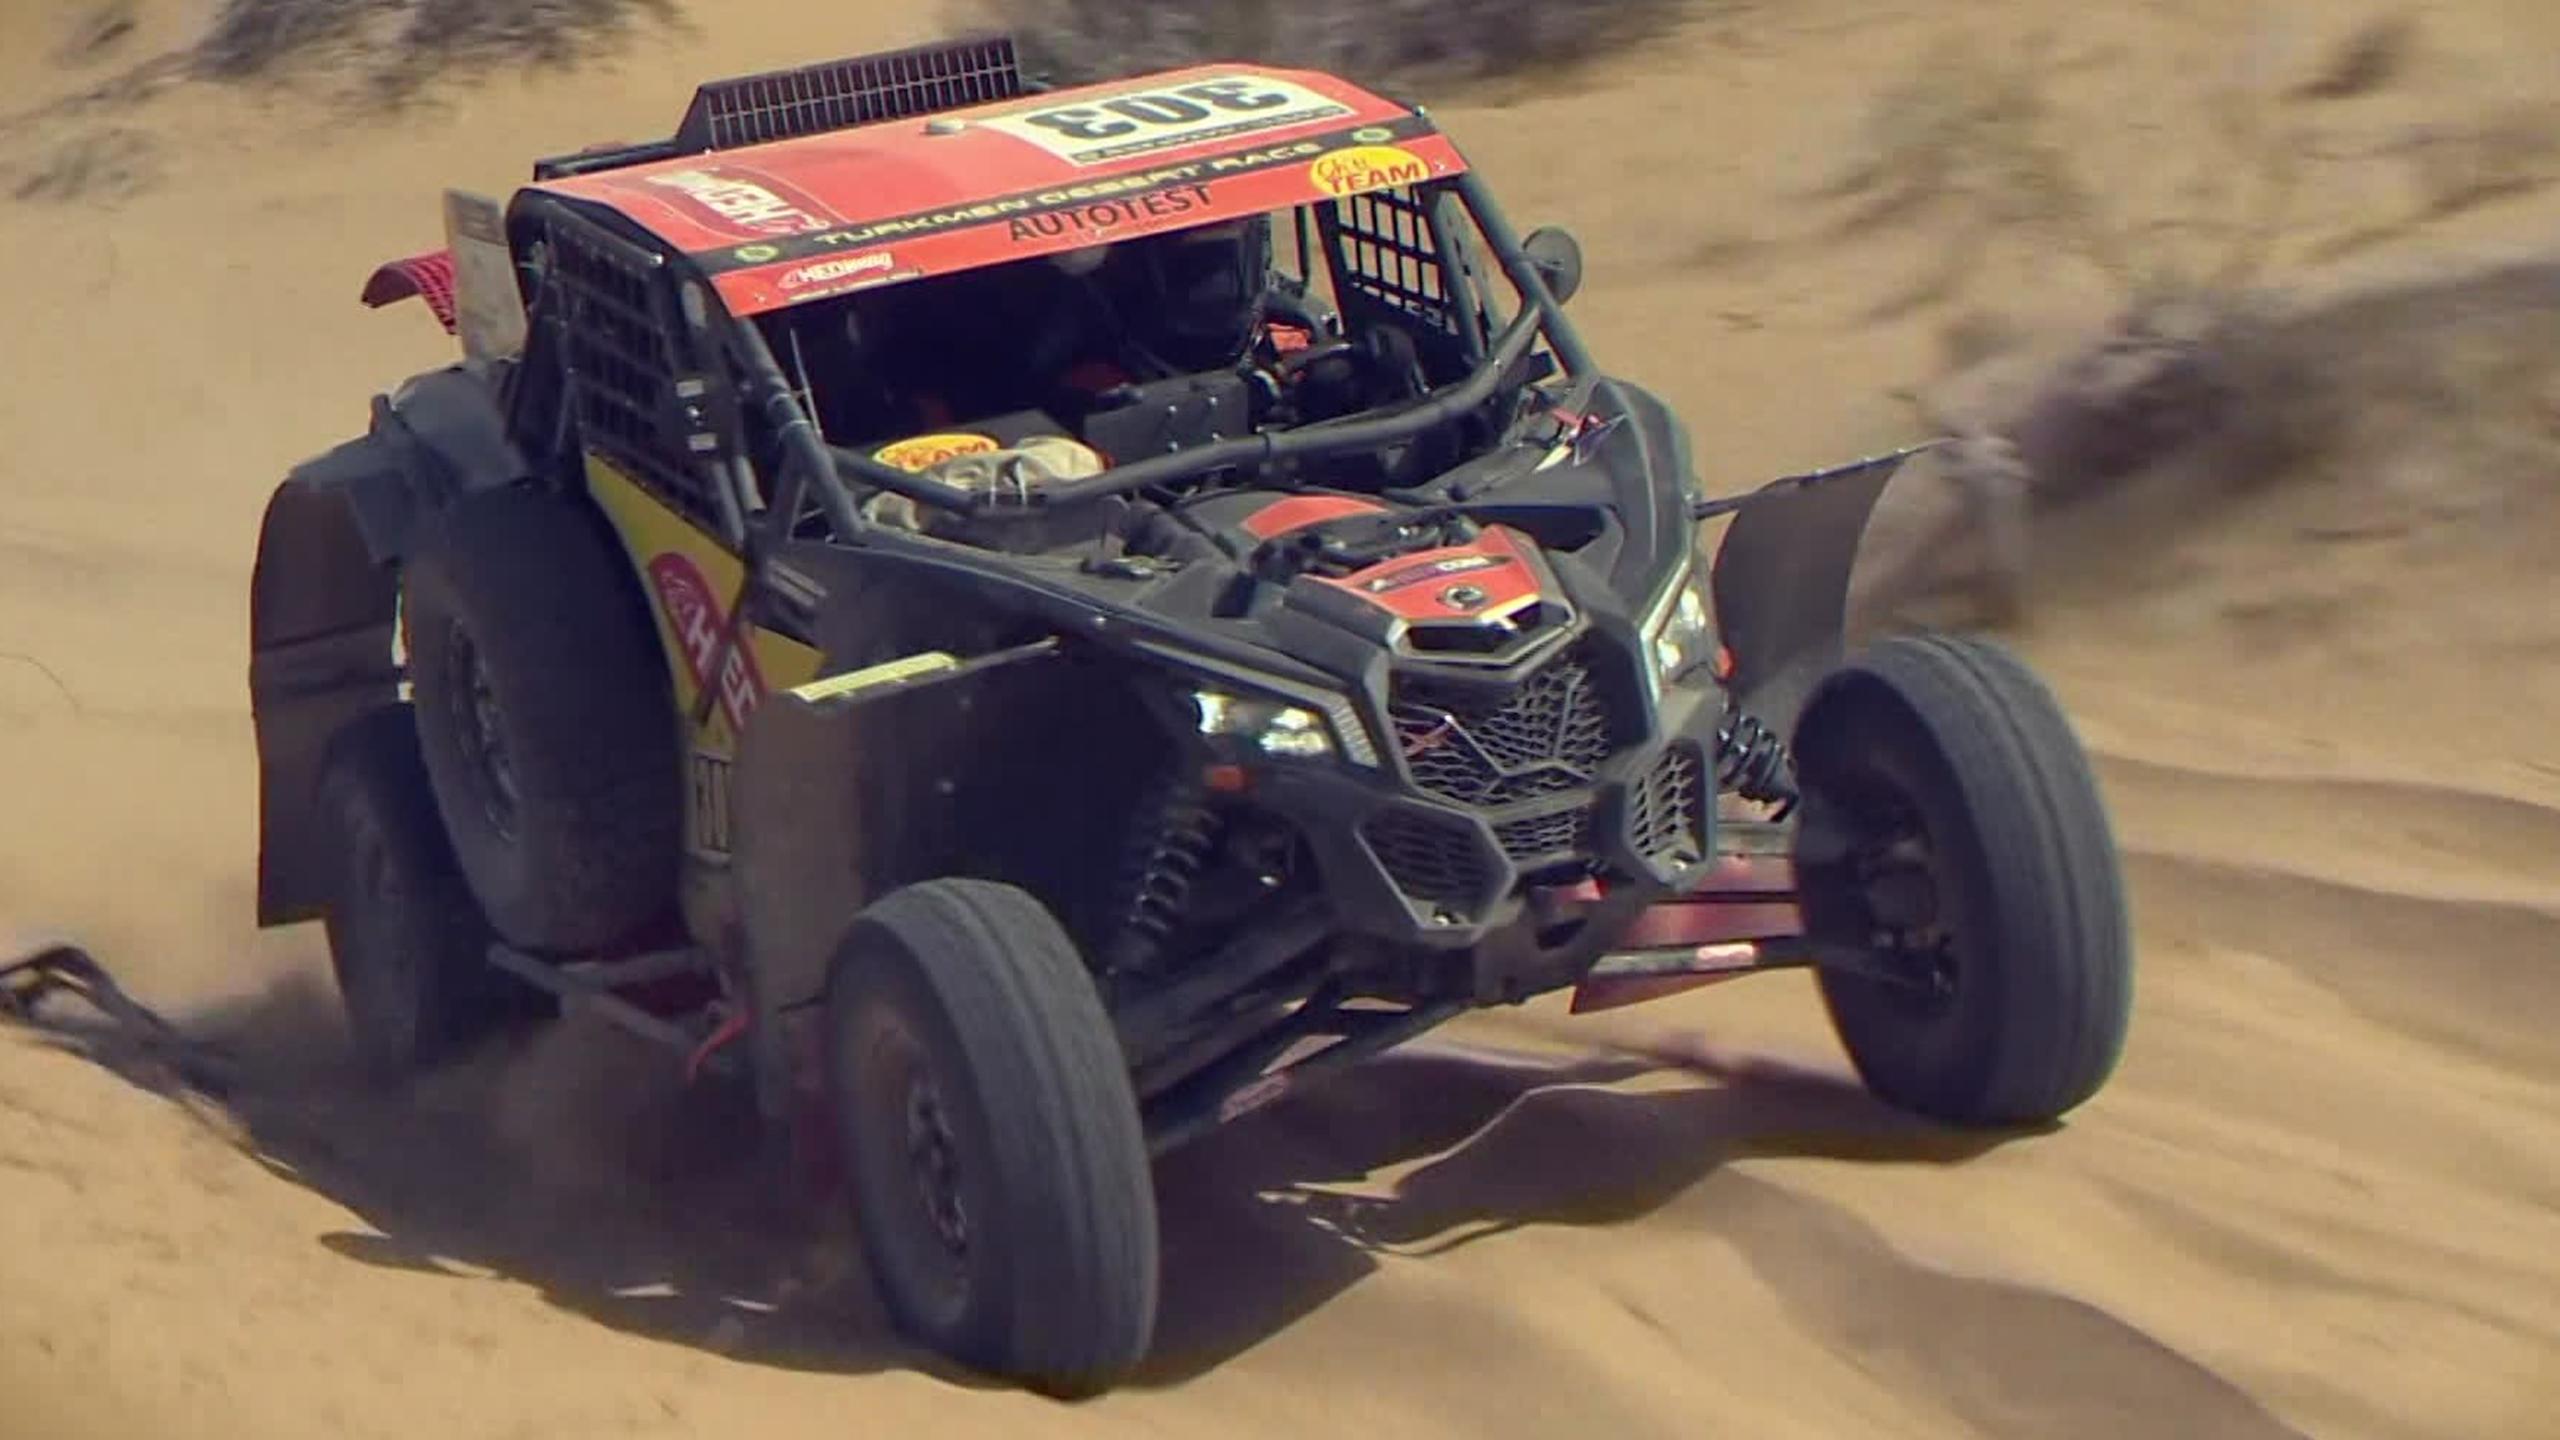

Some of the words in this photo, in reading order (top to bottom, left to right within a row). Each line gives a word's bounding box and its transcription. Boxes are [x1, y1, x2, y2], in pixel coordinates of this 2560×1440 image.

[813, 198, 1030, 247] TURKMEN
[1038, 168, 1204, 208] DESERT
[1211, 144, 1323, 174] RACE
[1324, 162, 1421, 194] TEAM
[1010, 187, 1211, 241] AUTOTEST
